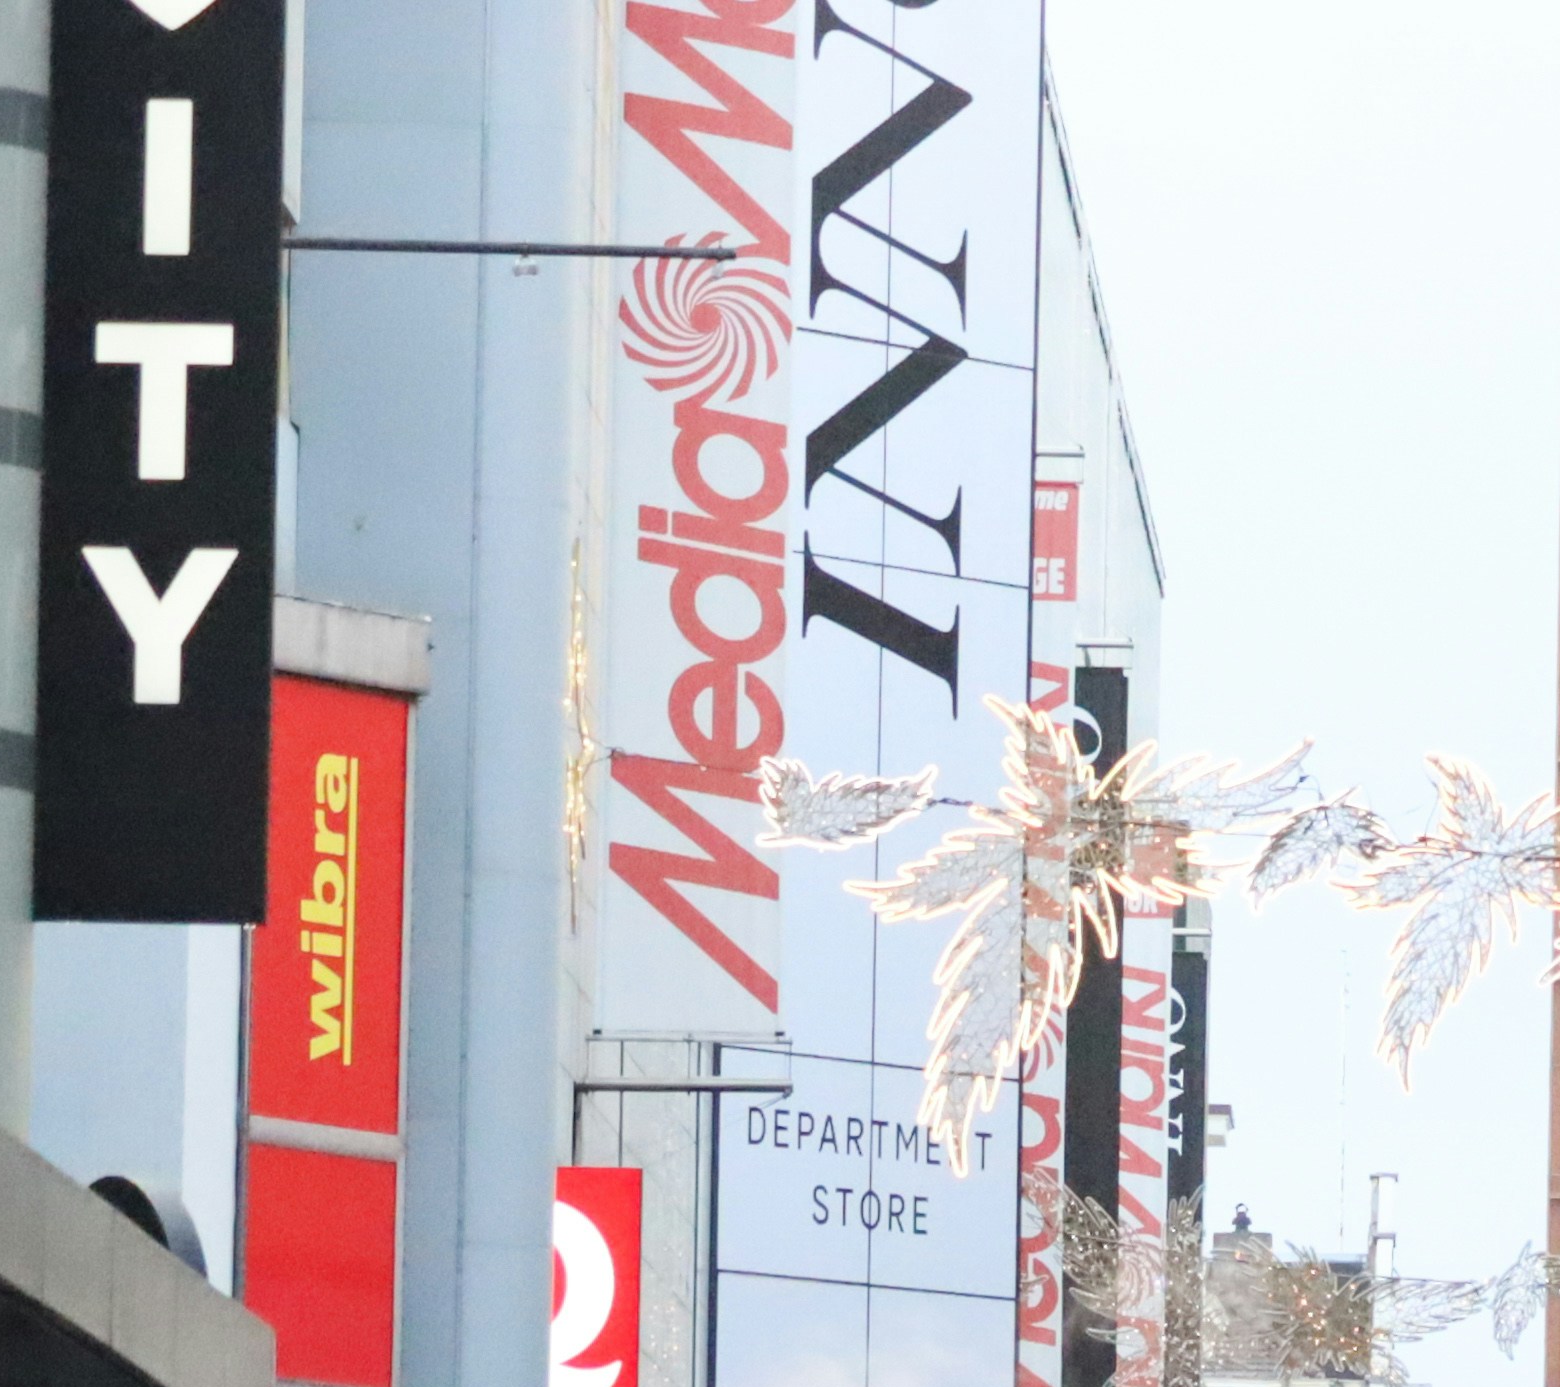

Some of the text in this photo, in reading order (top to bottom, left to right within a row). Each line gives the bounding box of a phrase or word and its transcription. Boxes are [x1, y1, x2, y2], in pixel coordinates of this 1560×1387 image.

[81, 0, 241, 706] ITY
[801, 0, 974, 720] INN
[300, 753, 350, 1065] wibra
[747, 1106, 994, 1171] DEPARTMET
[811, 1185, 930, 1236] STORE
